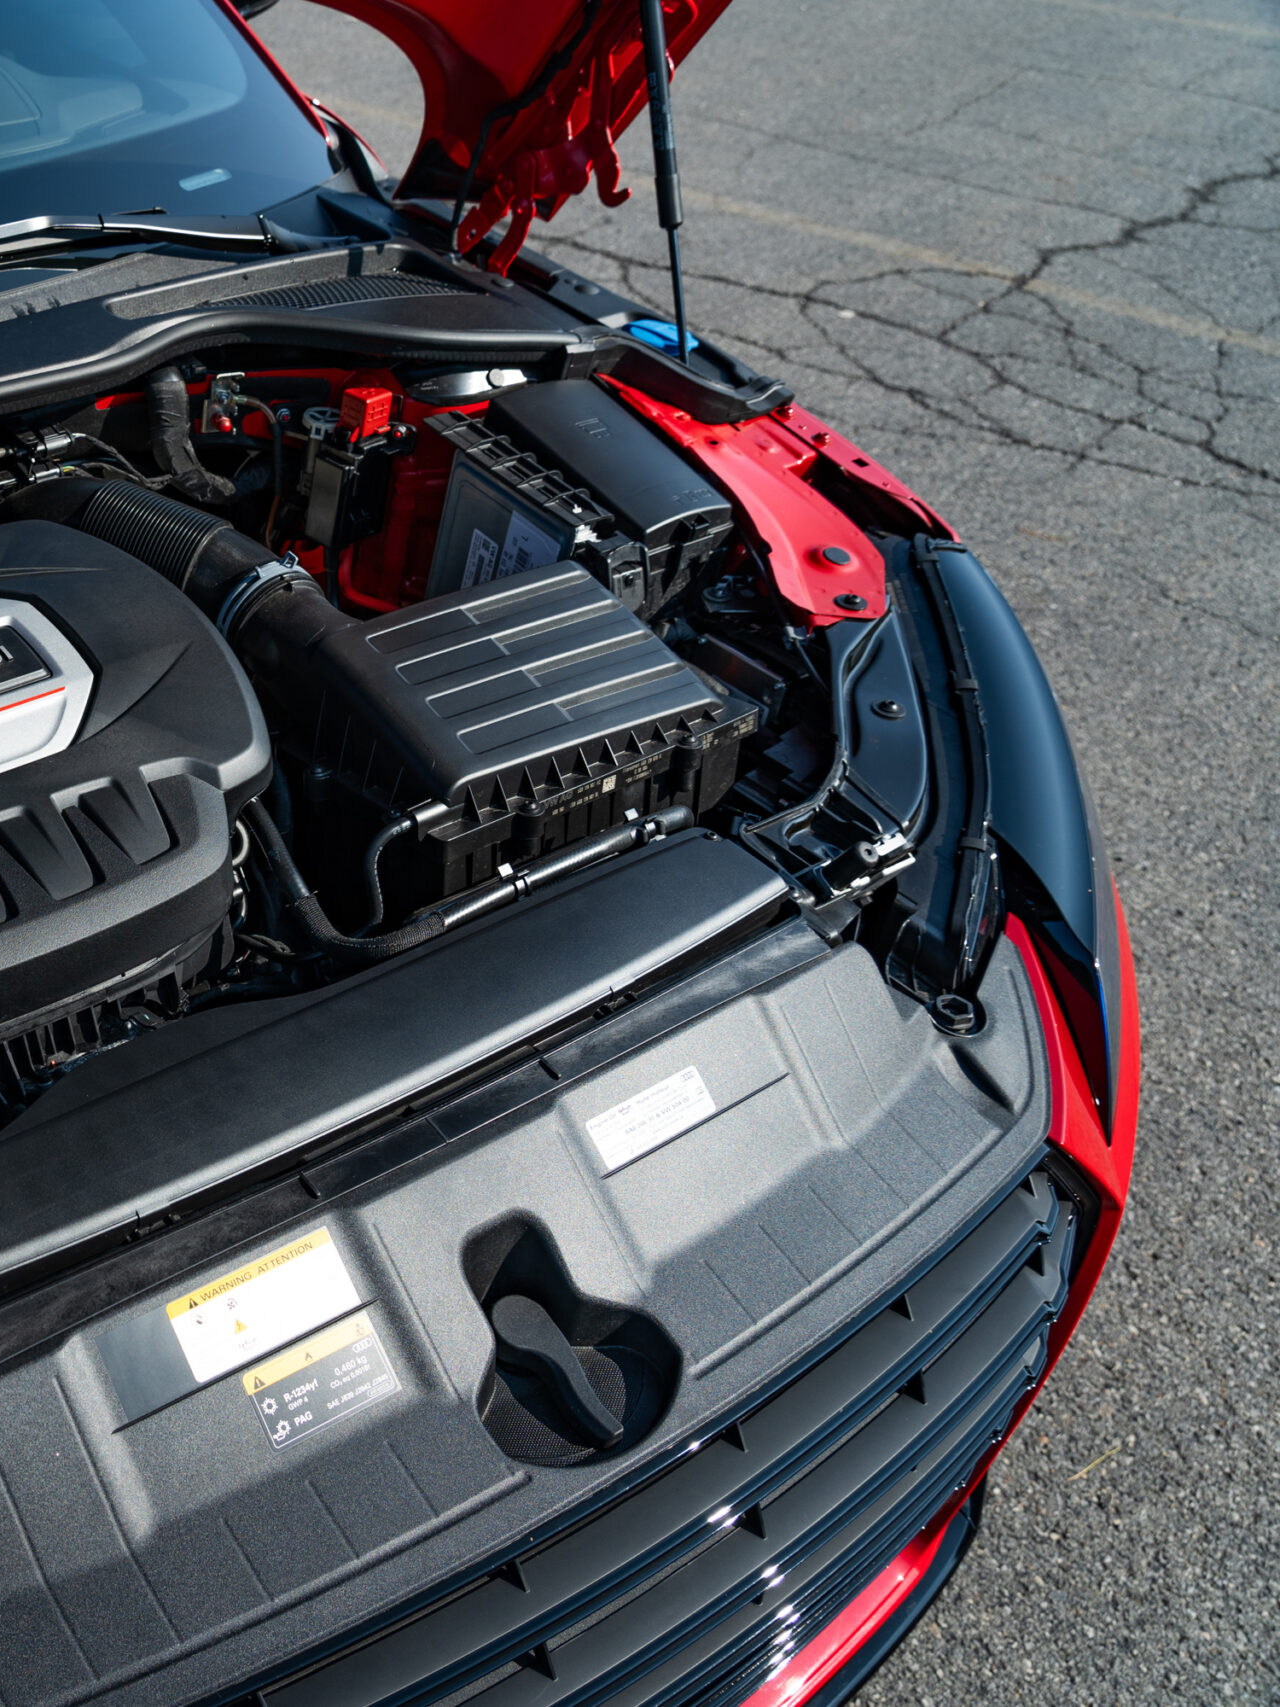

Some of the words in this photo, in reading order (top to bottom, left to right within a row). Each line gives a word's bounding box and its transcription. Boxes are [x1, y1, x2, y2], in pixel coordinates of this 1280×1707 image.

[200, 1272, 252, 1302] WARNING
[257, 1242, 313, 1274] ATTENTION
[356, 1356, 368, 1368] kg
[282, 1378, 319, 1403] R-1234yf
[288, 1399, 303, 1411] GWP
[327, 1399, 340, 1410] SAE
[294, 1410, 313, 1426] PAG
